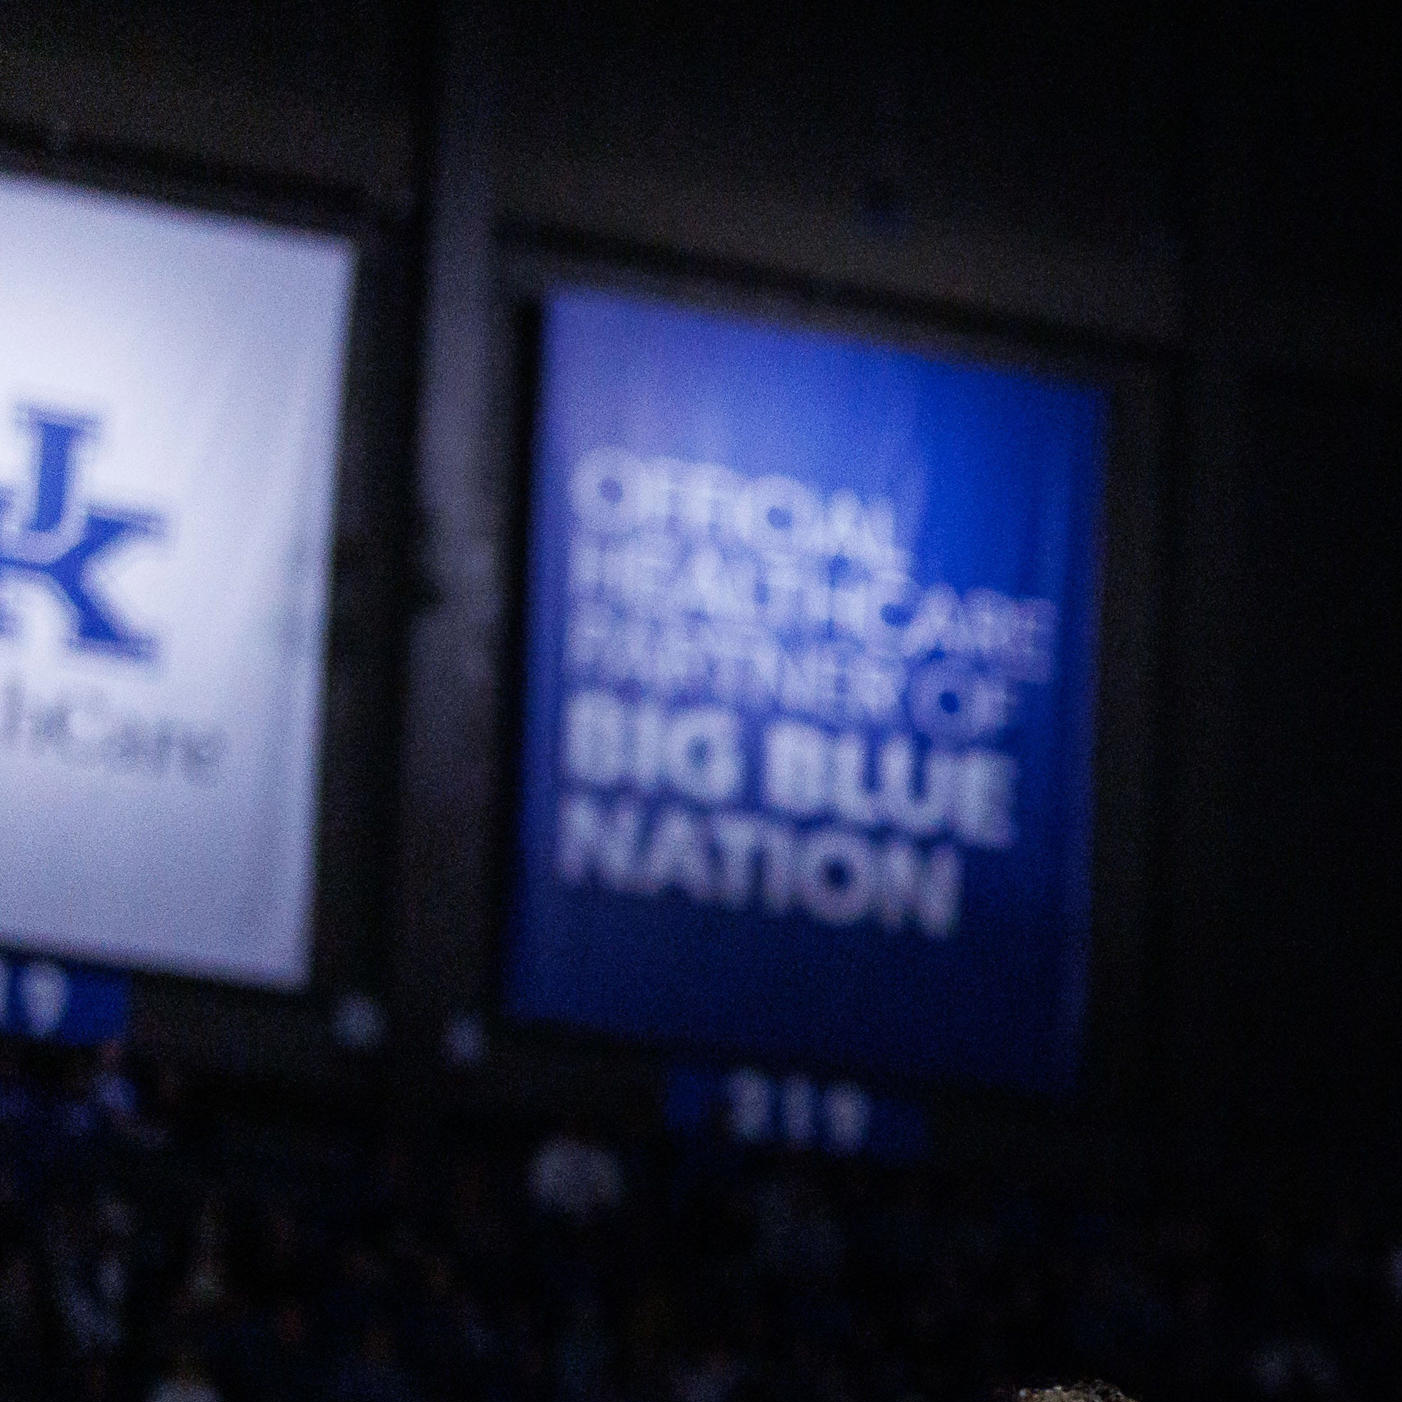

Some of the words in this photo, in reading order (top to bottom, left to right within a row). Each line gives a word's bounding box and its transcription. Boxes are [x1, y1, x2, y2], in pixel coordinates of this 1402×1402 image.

[574, 455, 904, 552] OFFICIAL
[570, 608, 900, 720] PARTNER
[910, 660, 1016, 738] OF
[574, 538, 1050, 680] HEALTHCARE
[566, 692, 742, 802] BIG
[765, 720, 1018, 848] BLUE
[562, 794, 960, 936] NATION
